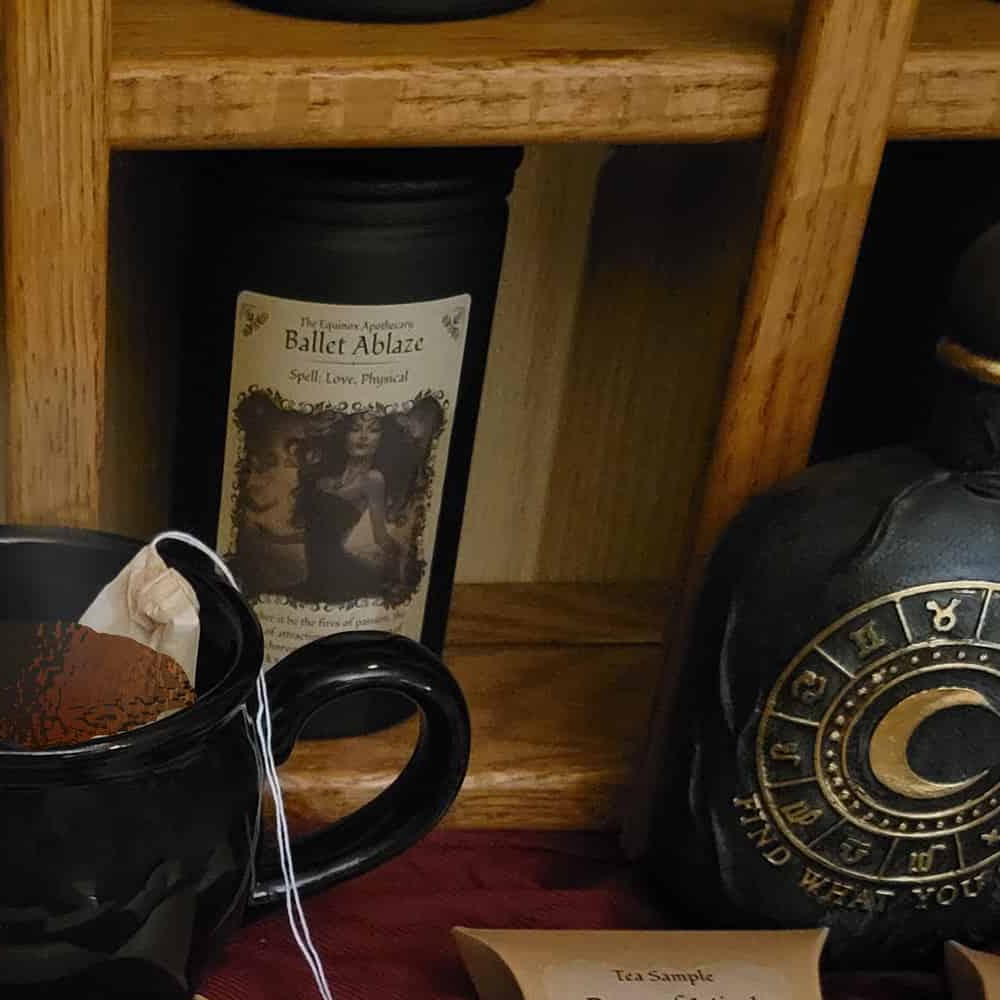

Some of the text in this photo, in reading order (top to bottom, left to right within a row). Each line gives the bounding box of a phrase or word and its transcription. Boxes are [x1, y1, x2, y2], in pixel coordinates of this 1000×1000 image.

[300, 317, 317, 329] The
[319, 319, 359, 331] Equinox
[284, 329, 424, 356] Ballet Ablaze
[361, 370, 408, 388] Physical
[733, 793, 791, 865] FIND
[612, 968, 714, 986] Tea Sample
